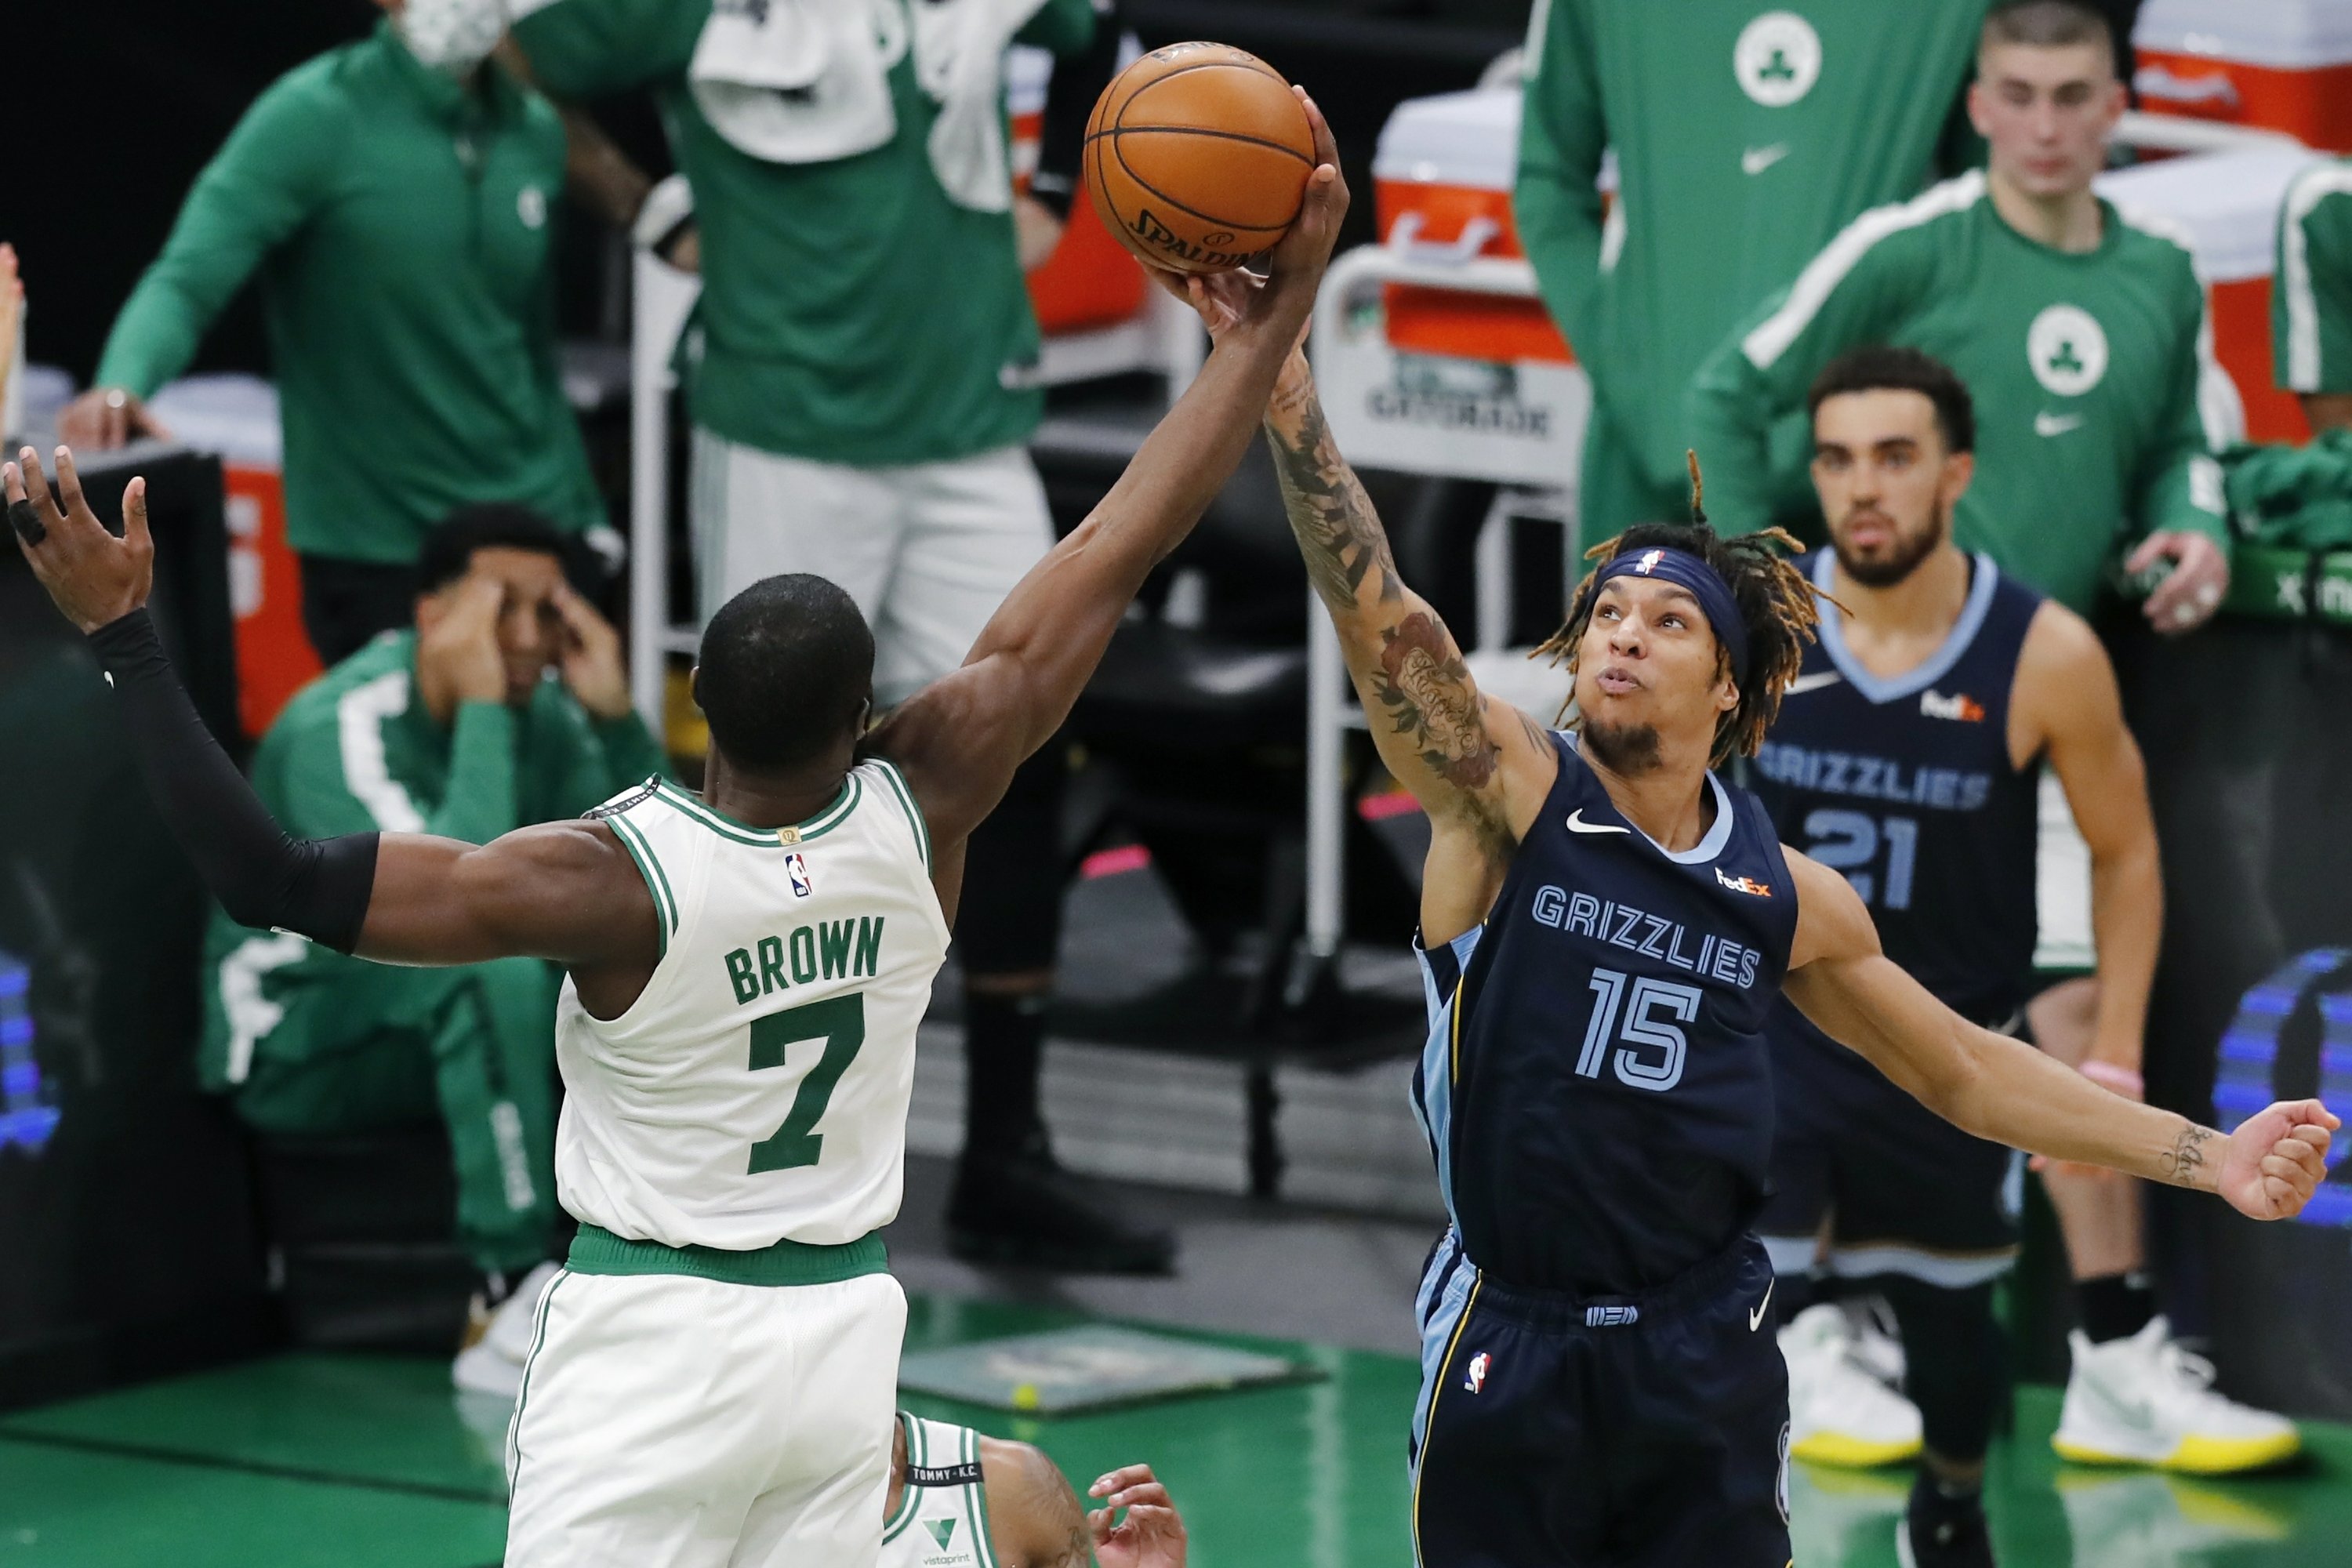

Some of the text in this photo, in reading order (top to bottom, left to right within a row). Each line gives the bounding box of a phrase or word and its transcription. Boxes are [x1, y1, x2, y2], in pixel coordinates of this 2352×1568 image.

[1129, 209, 1264, 267] SPALDIN
[1756, 742, 1991, 811] GRIZZLIES
[1715, 866, 1771, 898] FedEx
[1804, 809, 1918, 910] 21
[724, 916, 884, 1005] BROWN
[1532, 884, 1761, 989] GRIZZLIES
[1574, 967, 1703, 1091] 15
[747, 992, 866, 1175] 7
[913, 1468, 950, 1481] TOMMY
[923, 1553, 971, 1566] vistaprint
